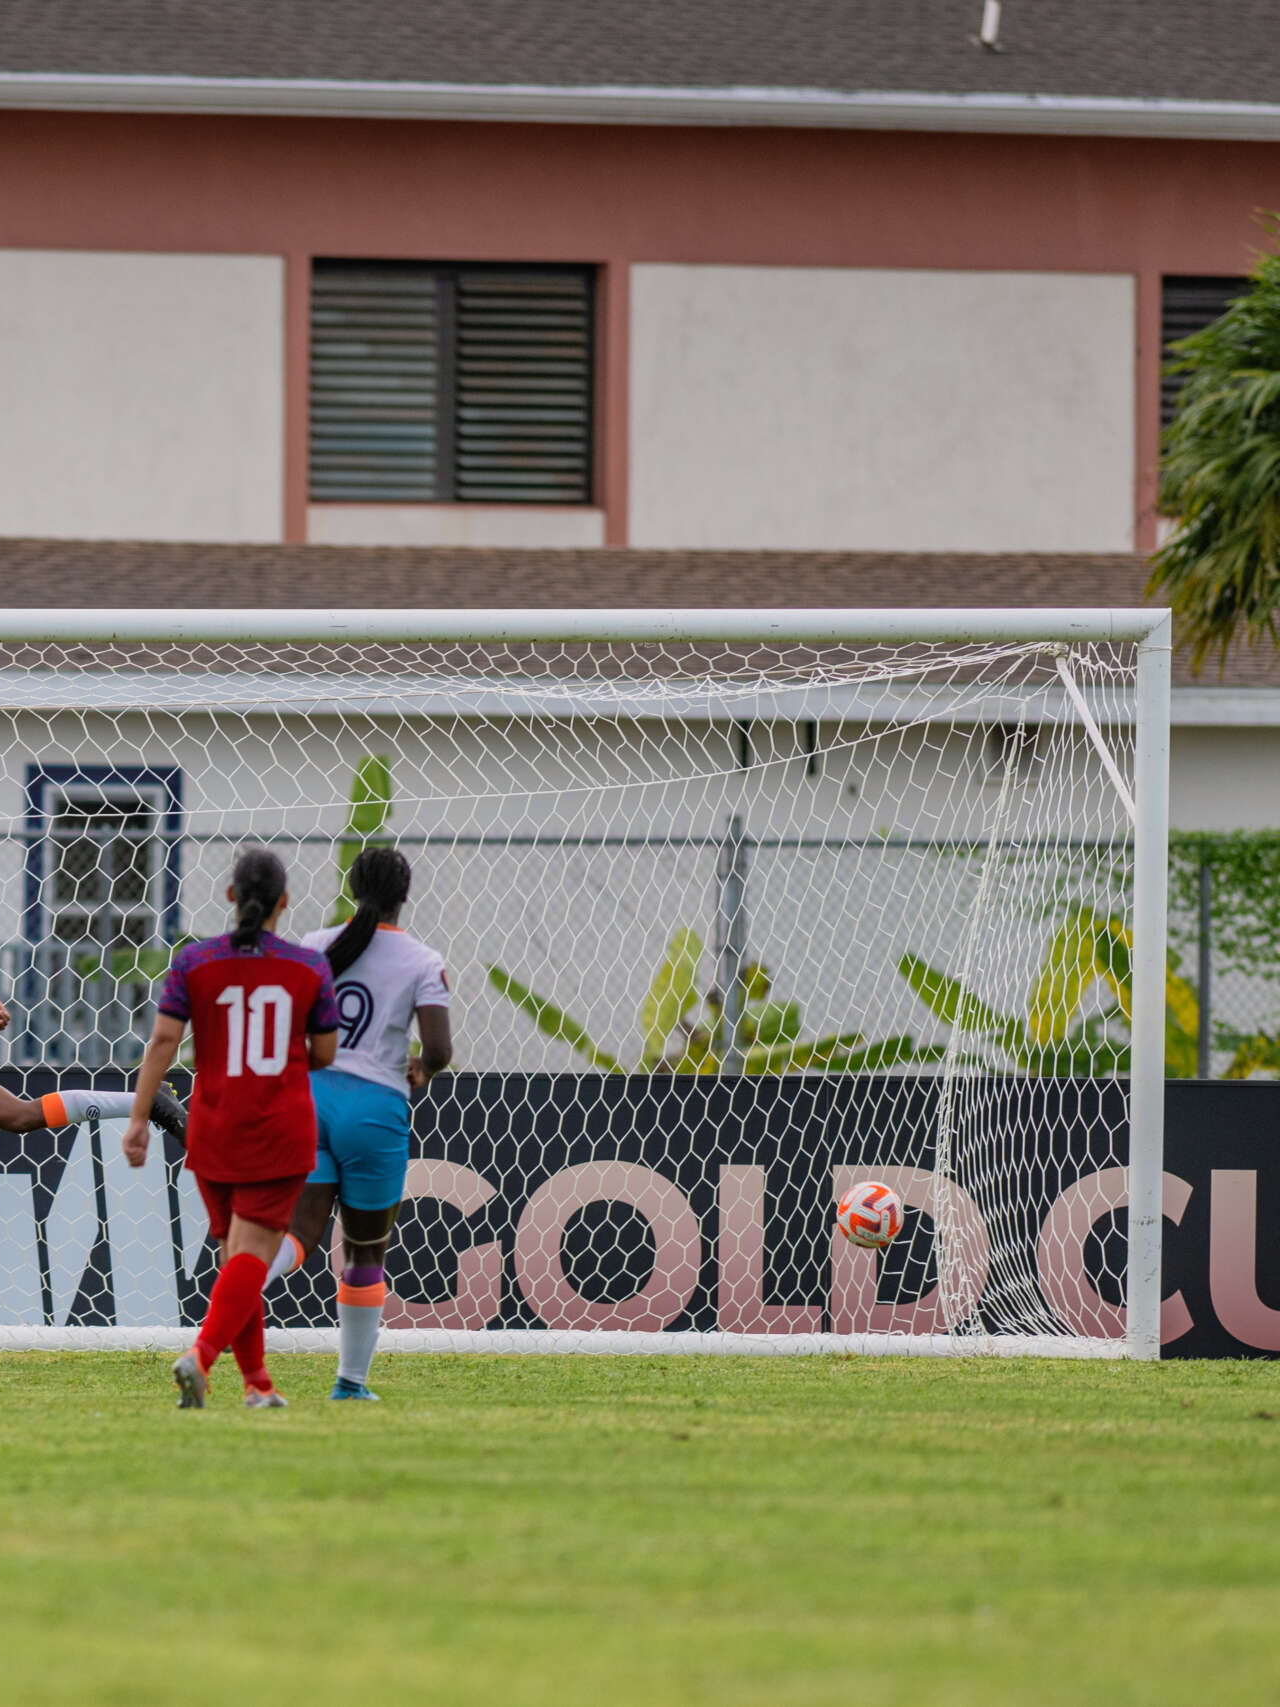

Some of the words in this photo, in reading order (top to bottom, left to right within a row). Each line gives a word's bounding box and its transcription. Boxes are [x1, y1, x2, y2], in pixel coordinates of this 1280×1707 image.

[216, 985, 293, 1077] 10
[335, 981, 374, 1049] 9
[330, 1158, 989, 1335] GOLD
[1037, 1166, 1280, 1352] CU
